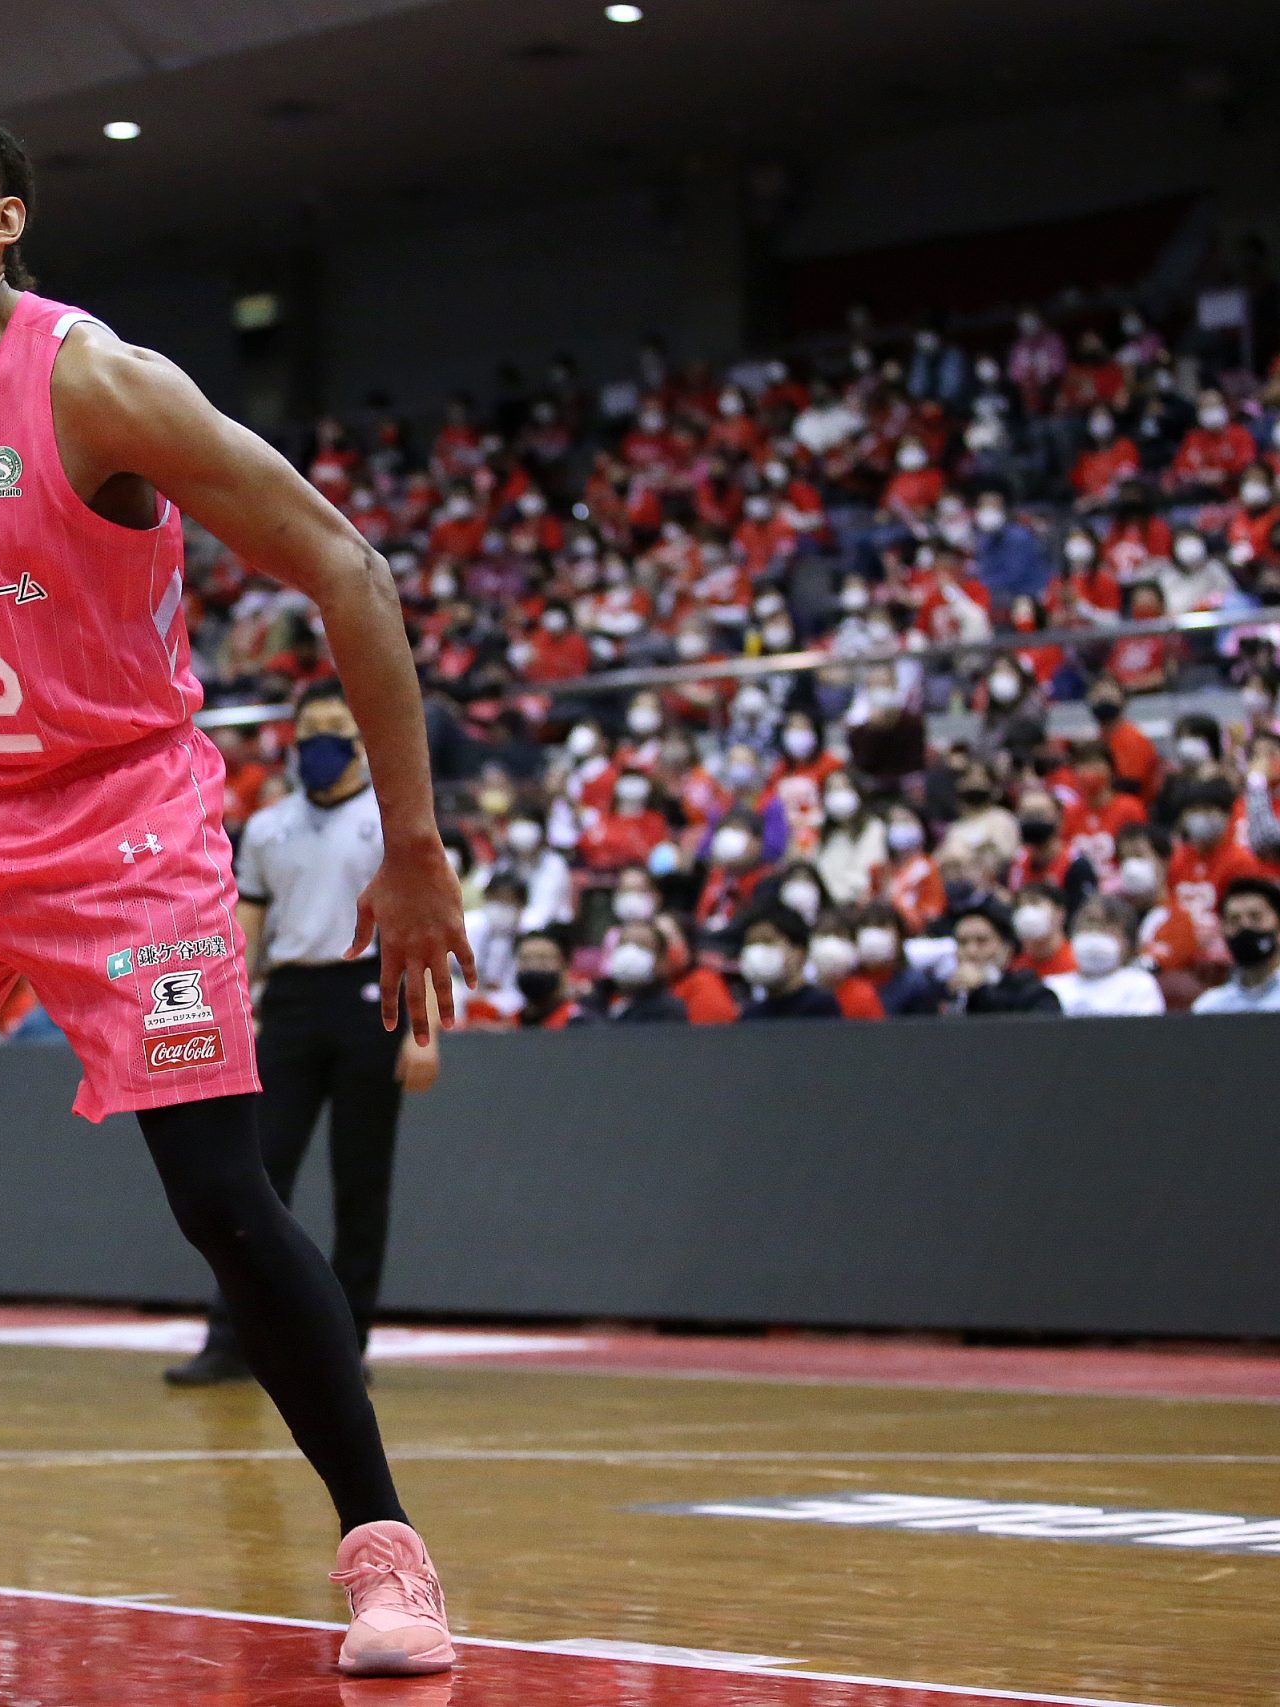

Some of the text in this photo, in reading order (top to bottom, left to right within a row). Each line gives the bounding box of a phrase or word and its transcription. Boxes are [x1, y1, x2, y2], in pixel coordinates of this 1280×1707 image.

[147, 1010, 212, 1027] スワローロジスティクス
[151, 1034, 217, 1067] Coca-Cola
